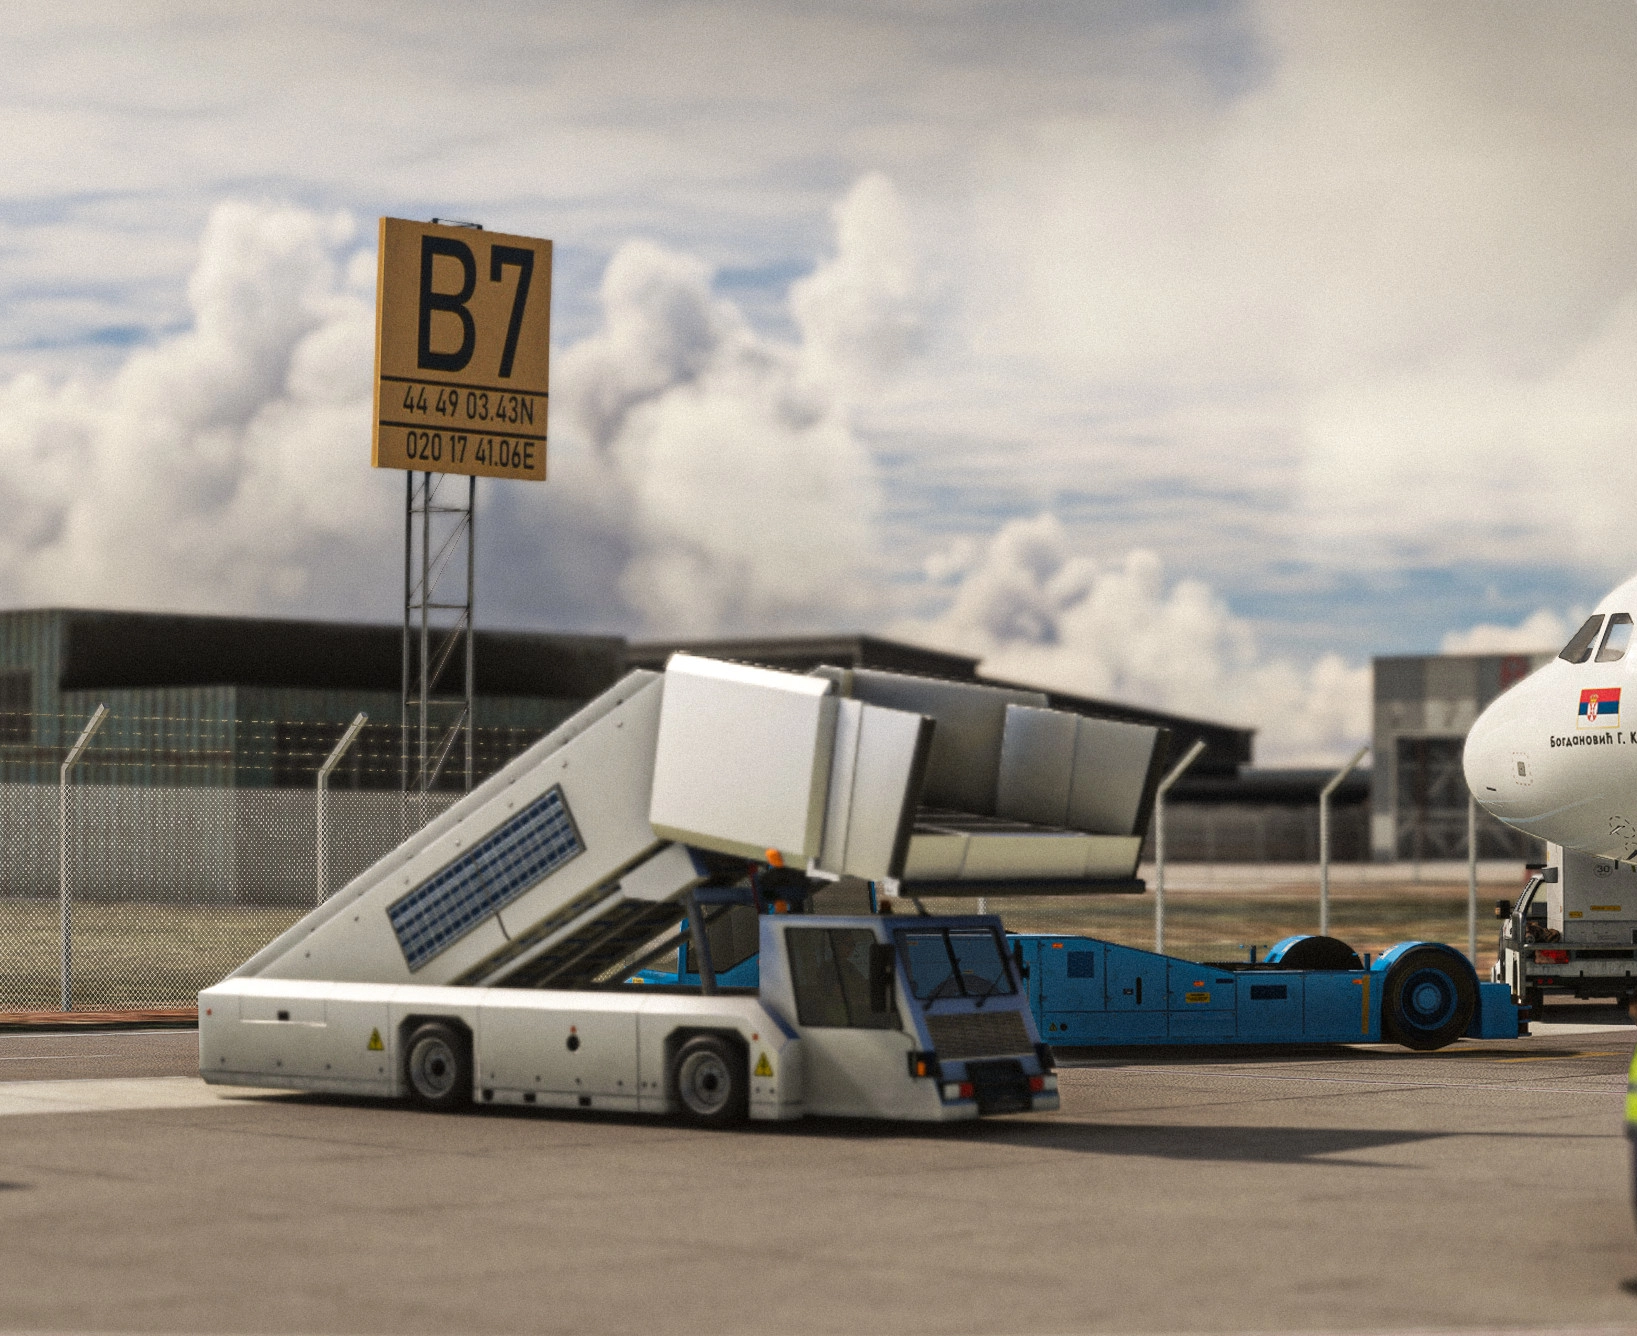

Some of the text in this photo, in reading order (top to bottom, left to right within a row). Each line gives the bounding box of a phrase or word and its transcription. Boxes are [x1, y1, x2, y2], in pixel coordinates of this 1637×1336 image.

[417, 234, 535, 379] B7
[402, 385, 535, 426] 44 49 03.43N
[406, 430, 535, 470] 020 17 41.06E
[1550, 732, 1613, 748] Богдановић
[1596, 864, 1611, 873] 30
